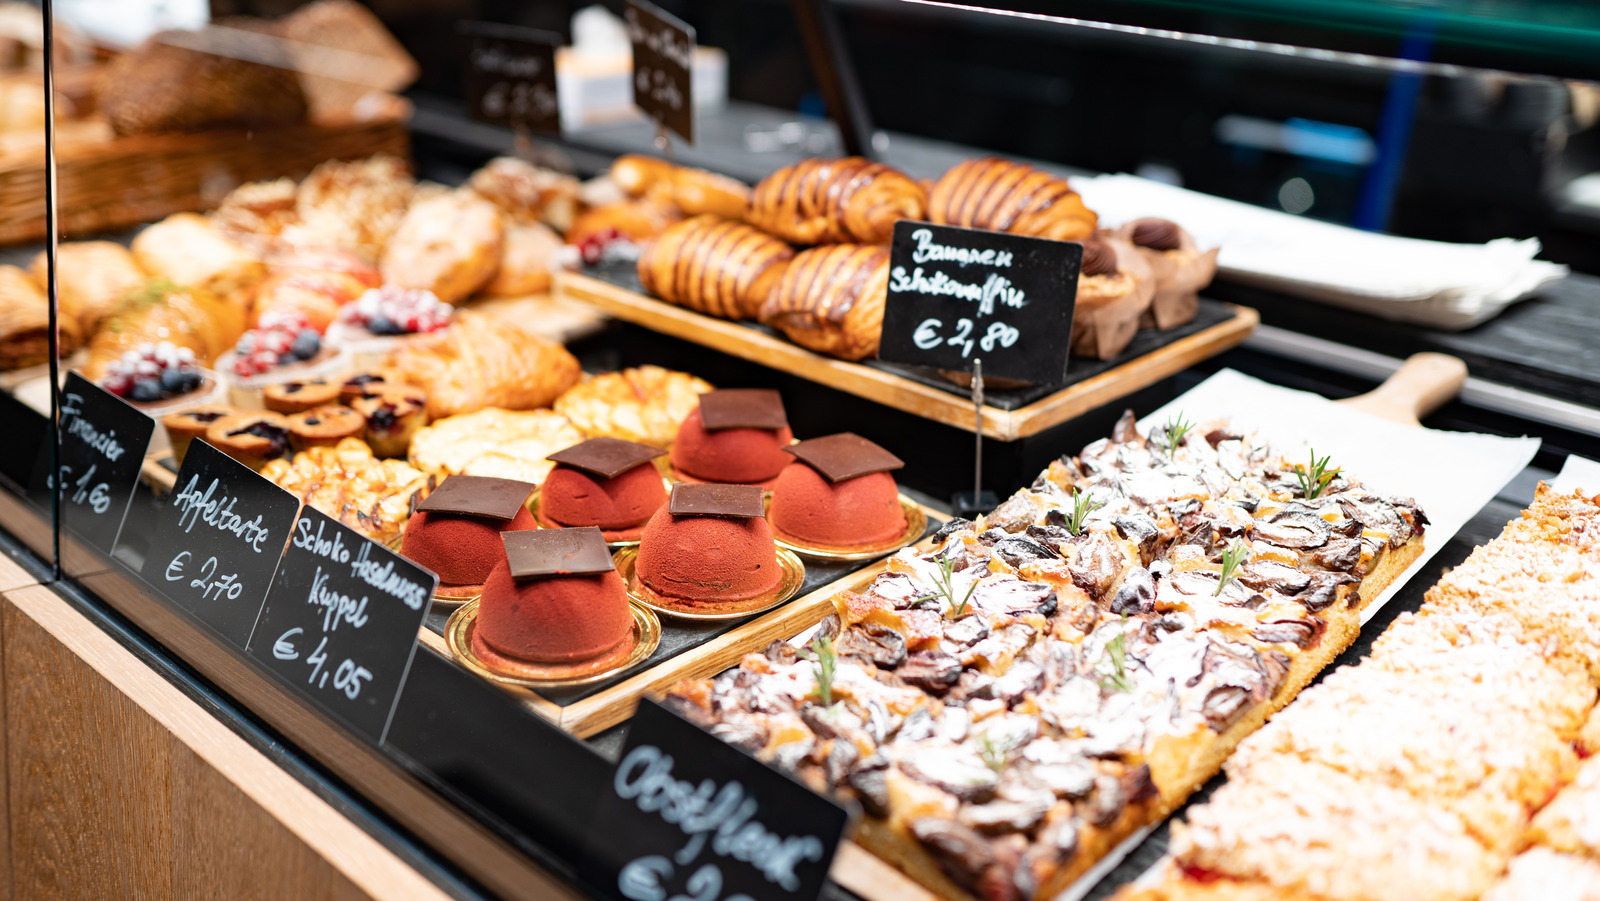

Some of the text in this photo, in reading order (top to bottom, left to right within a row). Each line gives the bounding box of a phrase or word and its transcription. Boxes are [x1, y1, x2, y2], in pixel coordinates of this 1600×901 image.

[912, 317, 1020, 358] € 2,80
[58, 393, 125, 462] Financier
[72, 464, 111, 514] 1,60
[173, 473, 269, 553] Apfeltarte
[165, 551, 243, 601] € 2,70
[293, 517, 427, 611] Schoko Haselnuss
[308, 566, 369, 632] Kuppel
[272, 627, 373, 700] € 4,05
